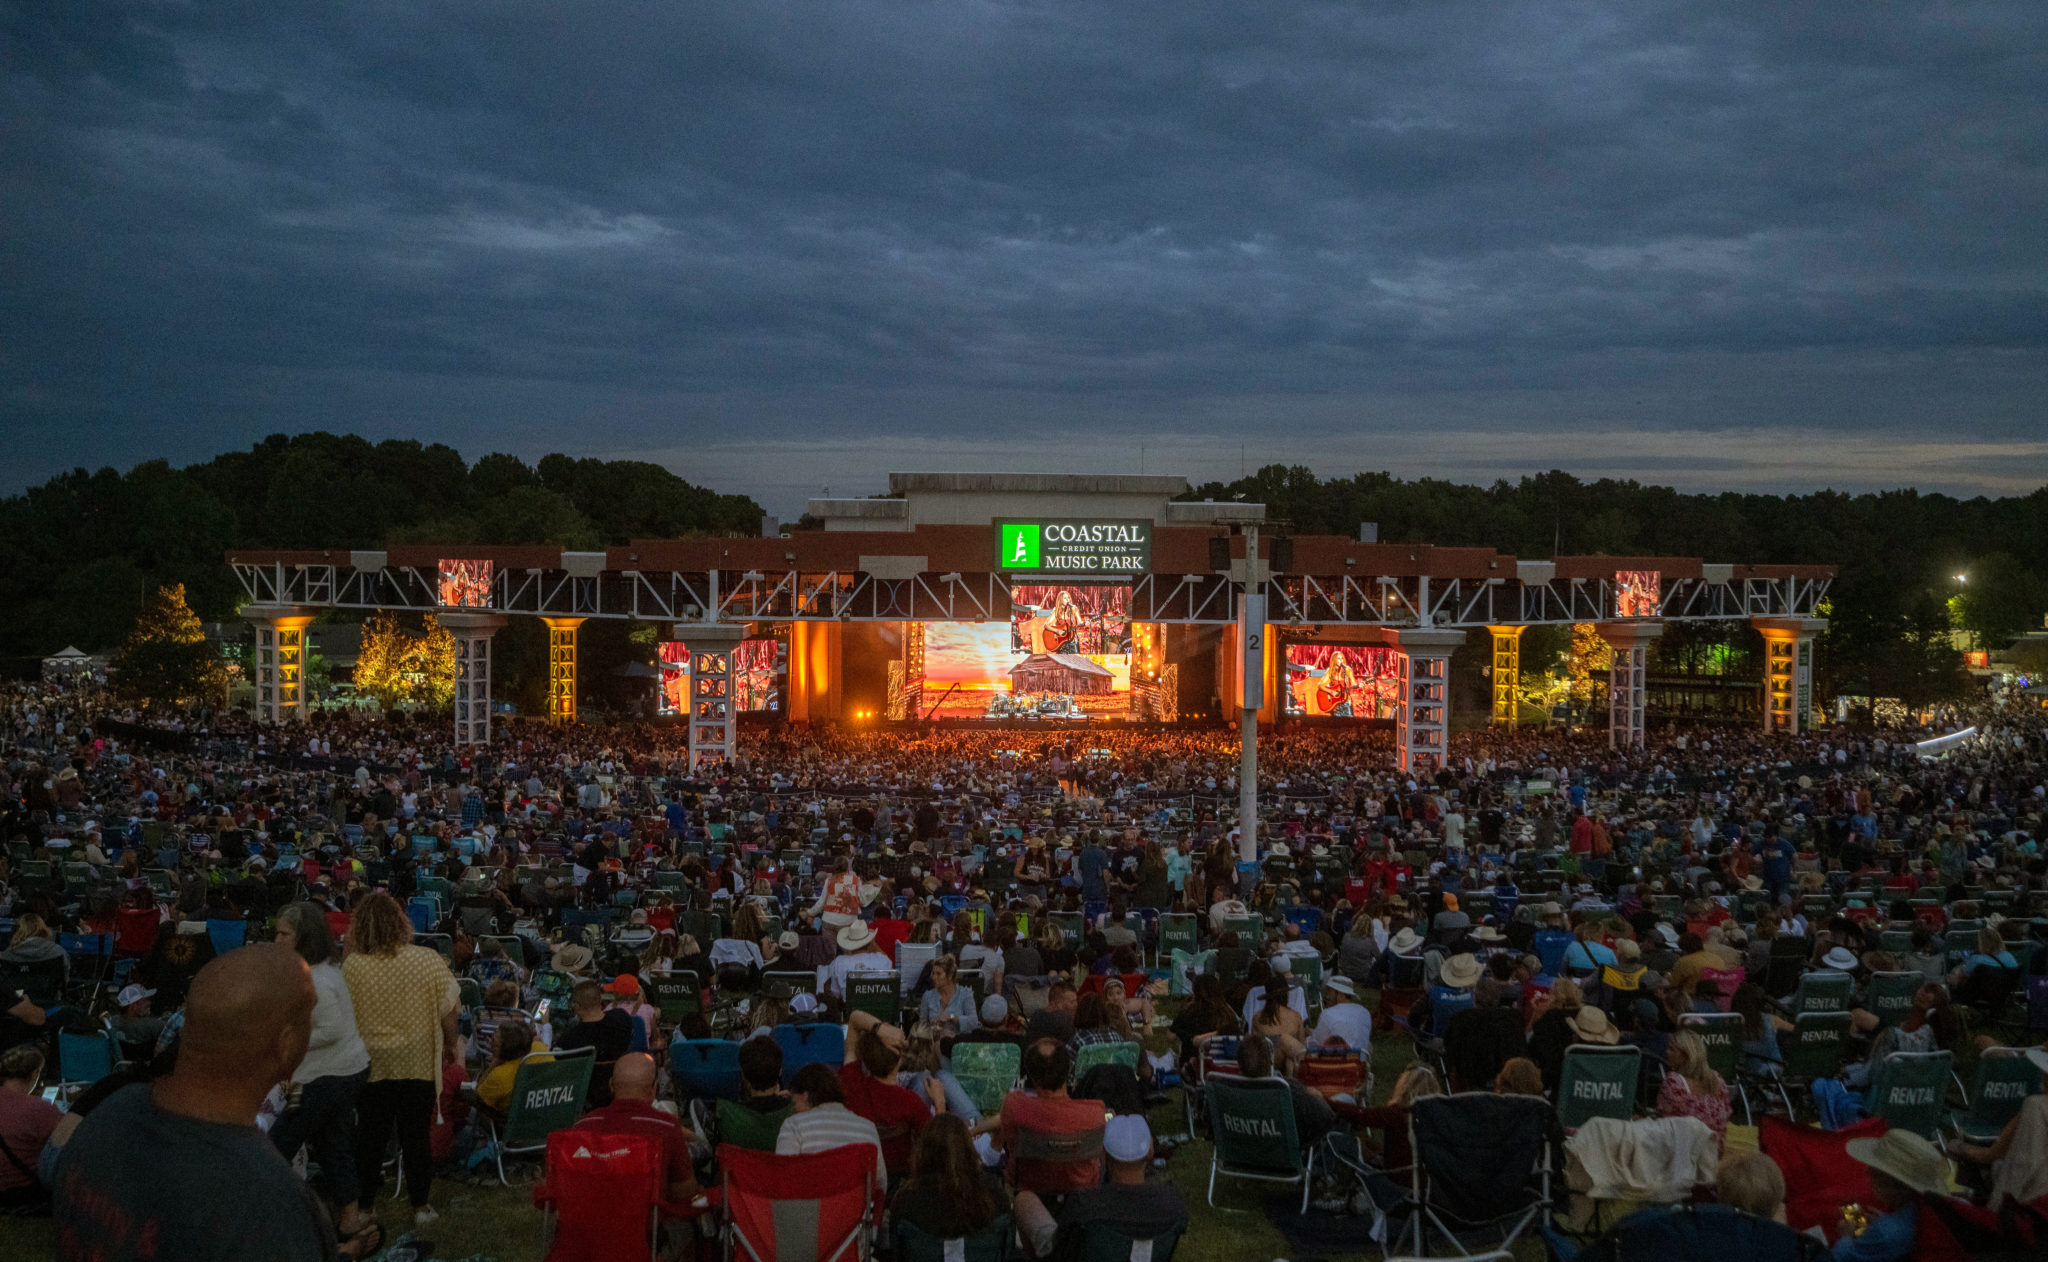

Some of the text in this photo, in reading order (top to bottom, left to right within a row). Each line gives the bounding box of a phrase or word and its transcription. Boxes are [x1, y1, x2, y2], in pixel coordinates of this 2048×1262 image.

[1045, 525, 1145, 543] COASTAL
[1045, 555, 1143, 569] MUSIC PARK
[1249, 635, 1260, 649] 2
[1060, 929, 1078, 938] NTAL
[1165, 930, 1191, 940] RENTAL
[1236, 930, 1253, 940] NTAL
[658, 984, 693, 994] RENTAL
[855, 984, 893, 994] RENTAL
[1804, 997, 1840, 1009] RENTAL
[1700, 1034, 1731, 1045] NTAL
[1801, 1030, 1840, 1041] RENTAL
[1573, 1081, 1624, 1100] RENTAL
[1889, 1087, 1935, 1105] RENTAL
[1984, 1081, 2028, 1099] RENTAL
[525, 1084, 574, 1110] RENTAL
[1223, 1113, 1281, 1137] RENTAL
